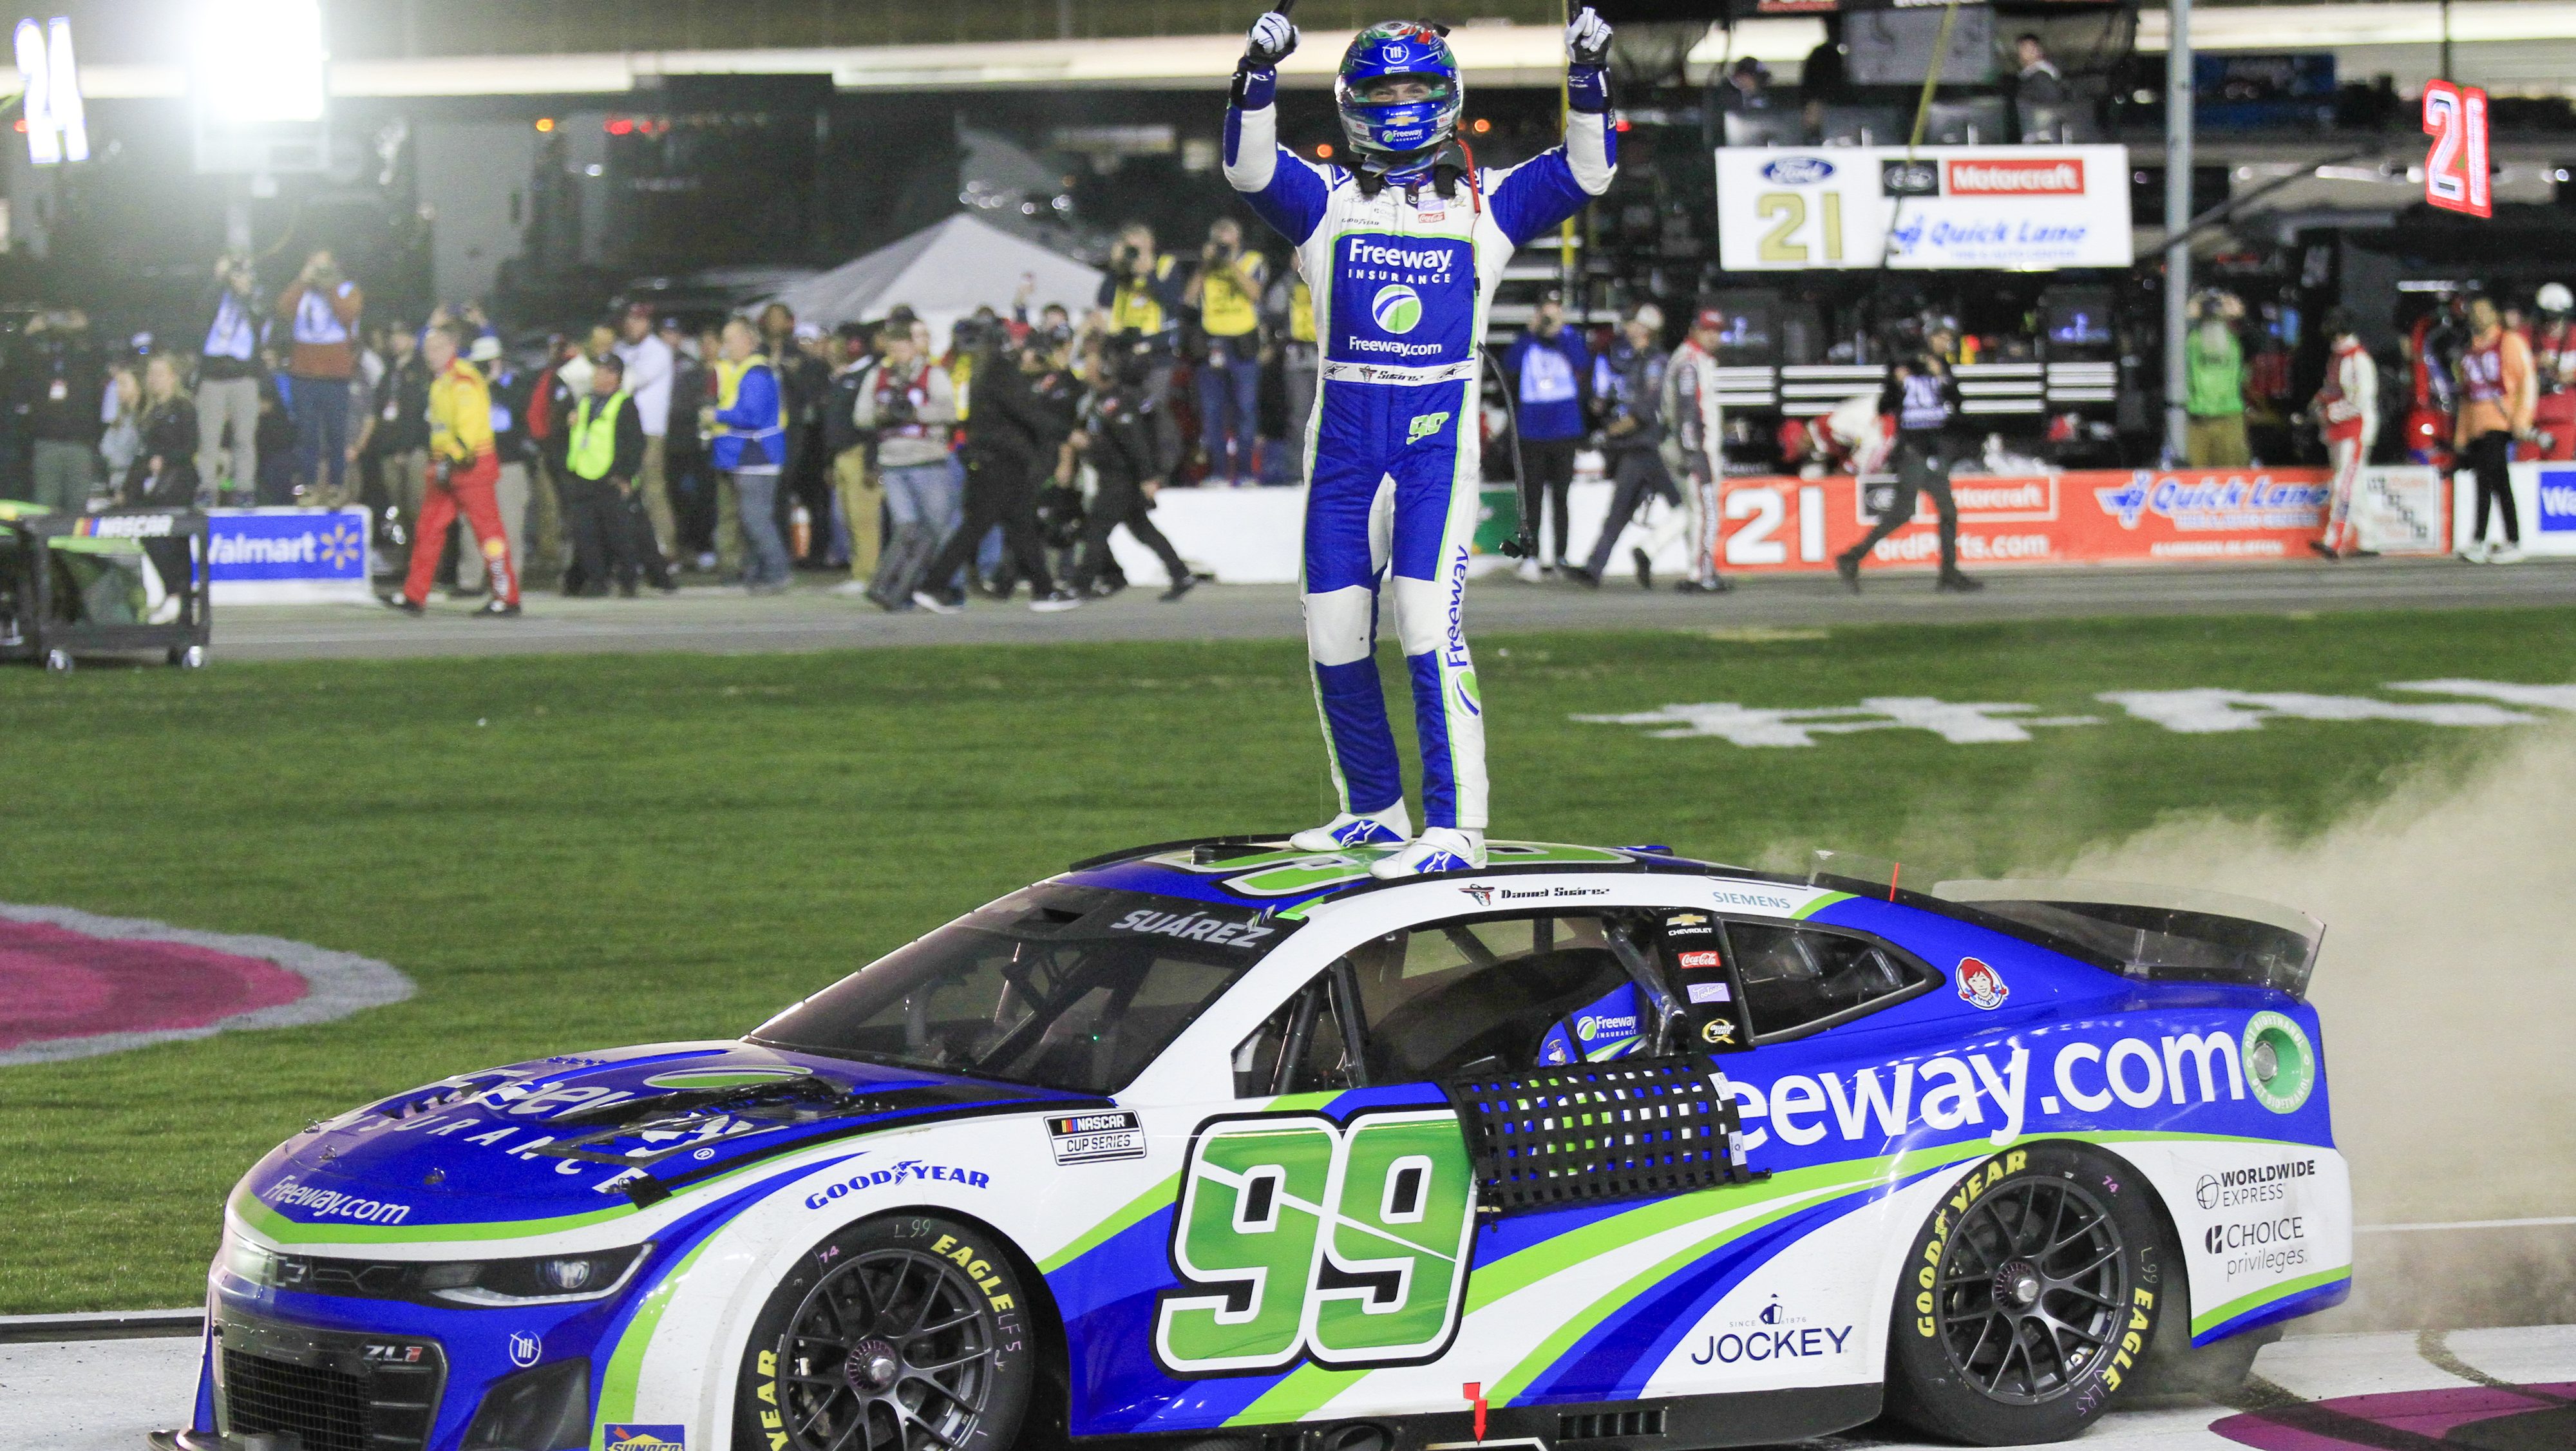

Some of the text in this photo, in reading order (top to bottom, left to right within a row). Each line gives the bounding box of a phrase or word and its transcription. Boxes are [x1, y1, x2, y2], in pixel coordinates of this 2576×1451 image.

[1393, 129, 1423, 138] Freeway
[2423, 79, 2492, 218] 21
[1953, 164, 2079, 190] Motorcraft
[1757, 193, 1842, 261] 21
[1931, 221, 2086, 246] Quick Lane
[1349, 238, 1453, 272] Freeway
[1349, 269, 1450, 284] INSURANCE
[1349, 336, 1442, 356] Freeway.com
[2151, 477, 2245, 513] Quick
[2248, 475, 2331, 509] Lane
[97, 515, 173, 538] NASCAR
[1725, 486, 1824, 564] 21
[1445, 544, 1469, 668] Freeway
[1501, 888, 1549, 899] Daniel
[1712, 891, 1791, 910] SIEMENS
[1111, 904, 1275, 948] SUÁREZ
[1668, 927, 1713, 936] CHEVROLET
[1596, 1016, 1636, 1029] Freeway
[1596, 1029, 1637, 1038] INSURANCE
[2253, 1015, 2305, 1048] BIOETHANOL
[1728, 1030, 2245, 1146] eeway.com
[1077, 1114, 1126, 1132] NASCAR
[1067, 1134, 1131, 1152] CUP SERIES
[2222, 1160, 2315, 1188] WORLDWIDE
[262, 1175, 411, 1224] Freeway.com
[2223, 1182, 2284, 1207] EXPRESS
[1149, 1102, 1479, 1381] 99
[2227, 1217, 2304, 1249] CHOICE
[931, 1234, 1015, 1313] EAGLE
[363, 1345, 423, 1362] ZL1
[1691, 1325, 1853, 1365] JOCKEY
[2101, 1287, 2154, 1392] EAGLE
